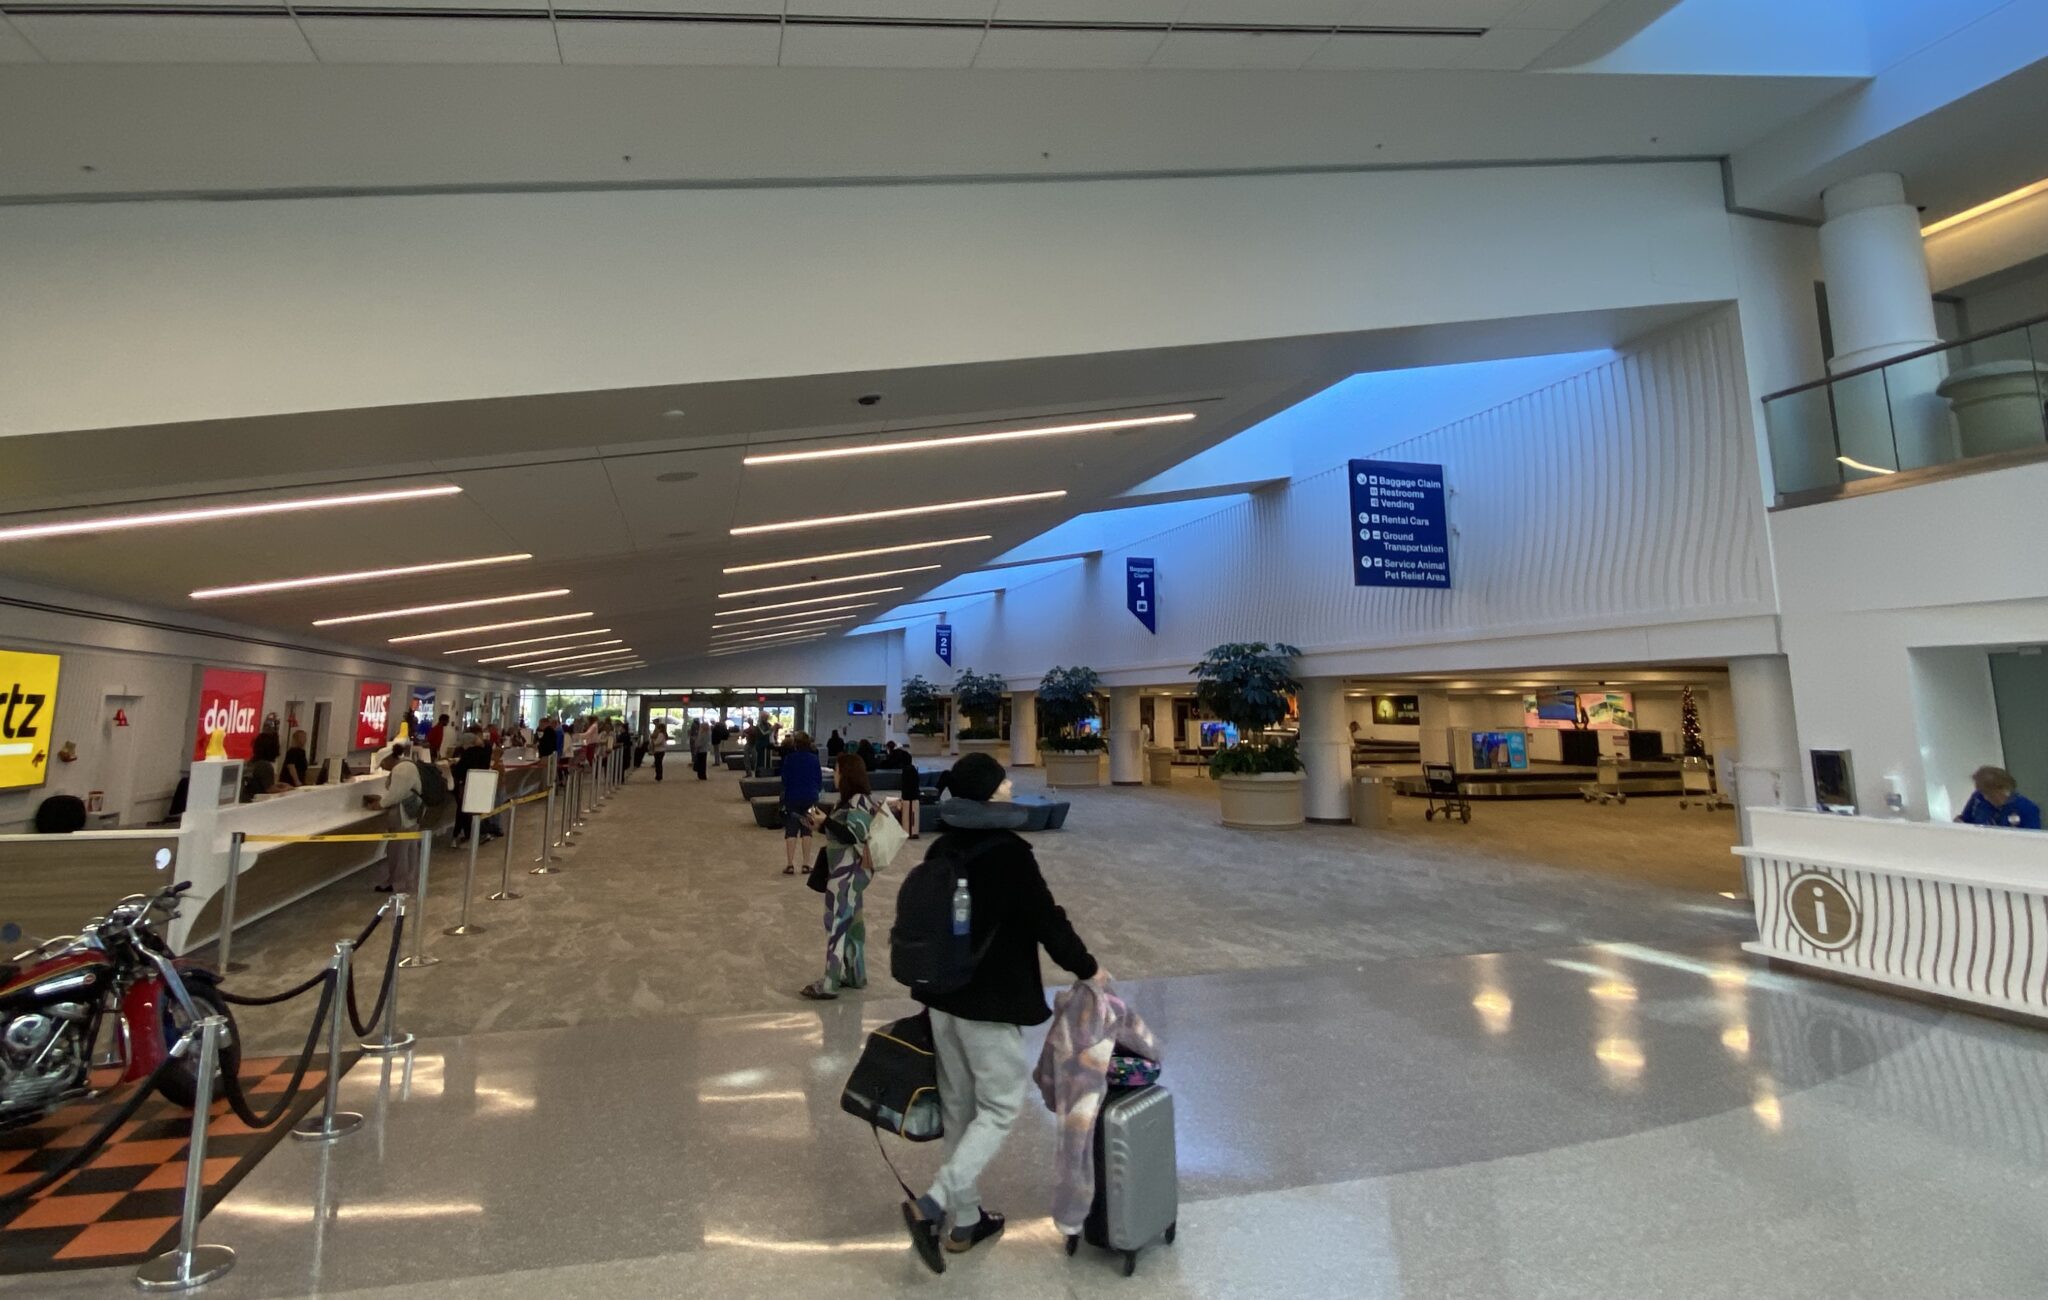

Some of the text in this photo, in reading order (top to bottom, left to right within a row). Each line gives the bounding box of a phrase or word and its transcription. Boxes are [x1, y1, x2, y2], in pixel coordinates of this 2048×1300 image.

[1379, 476, 1441, 489] Baggage Claim
[1380, 488, 1424, 499] Restrooms
[1381, 499, 1415, 510] Vending
[1381, 515, 1429, 526] Rental Cars
[1383, 531, 1414, 541] Ground
[1383, 542, 1444, 553] Transportation
[1384, 559, 1445, 570] Service Animal
[1385, 570, 1445, 582] Pet Relief Area
[1137, 581, 1144, 597] 1
[940, 637, 947, 647] 2
